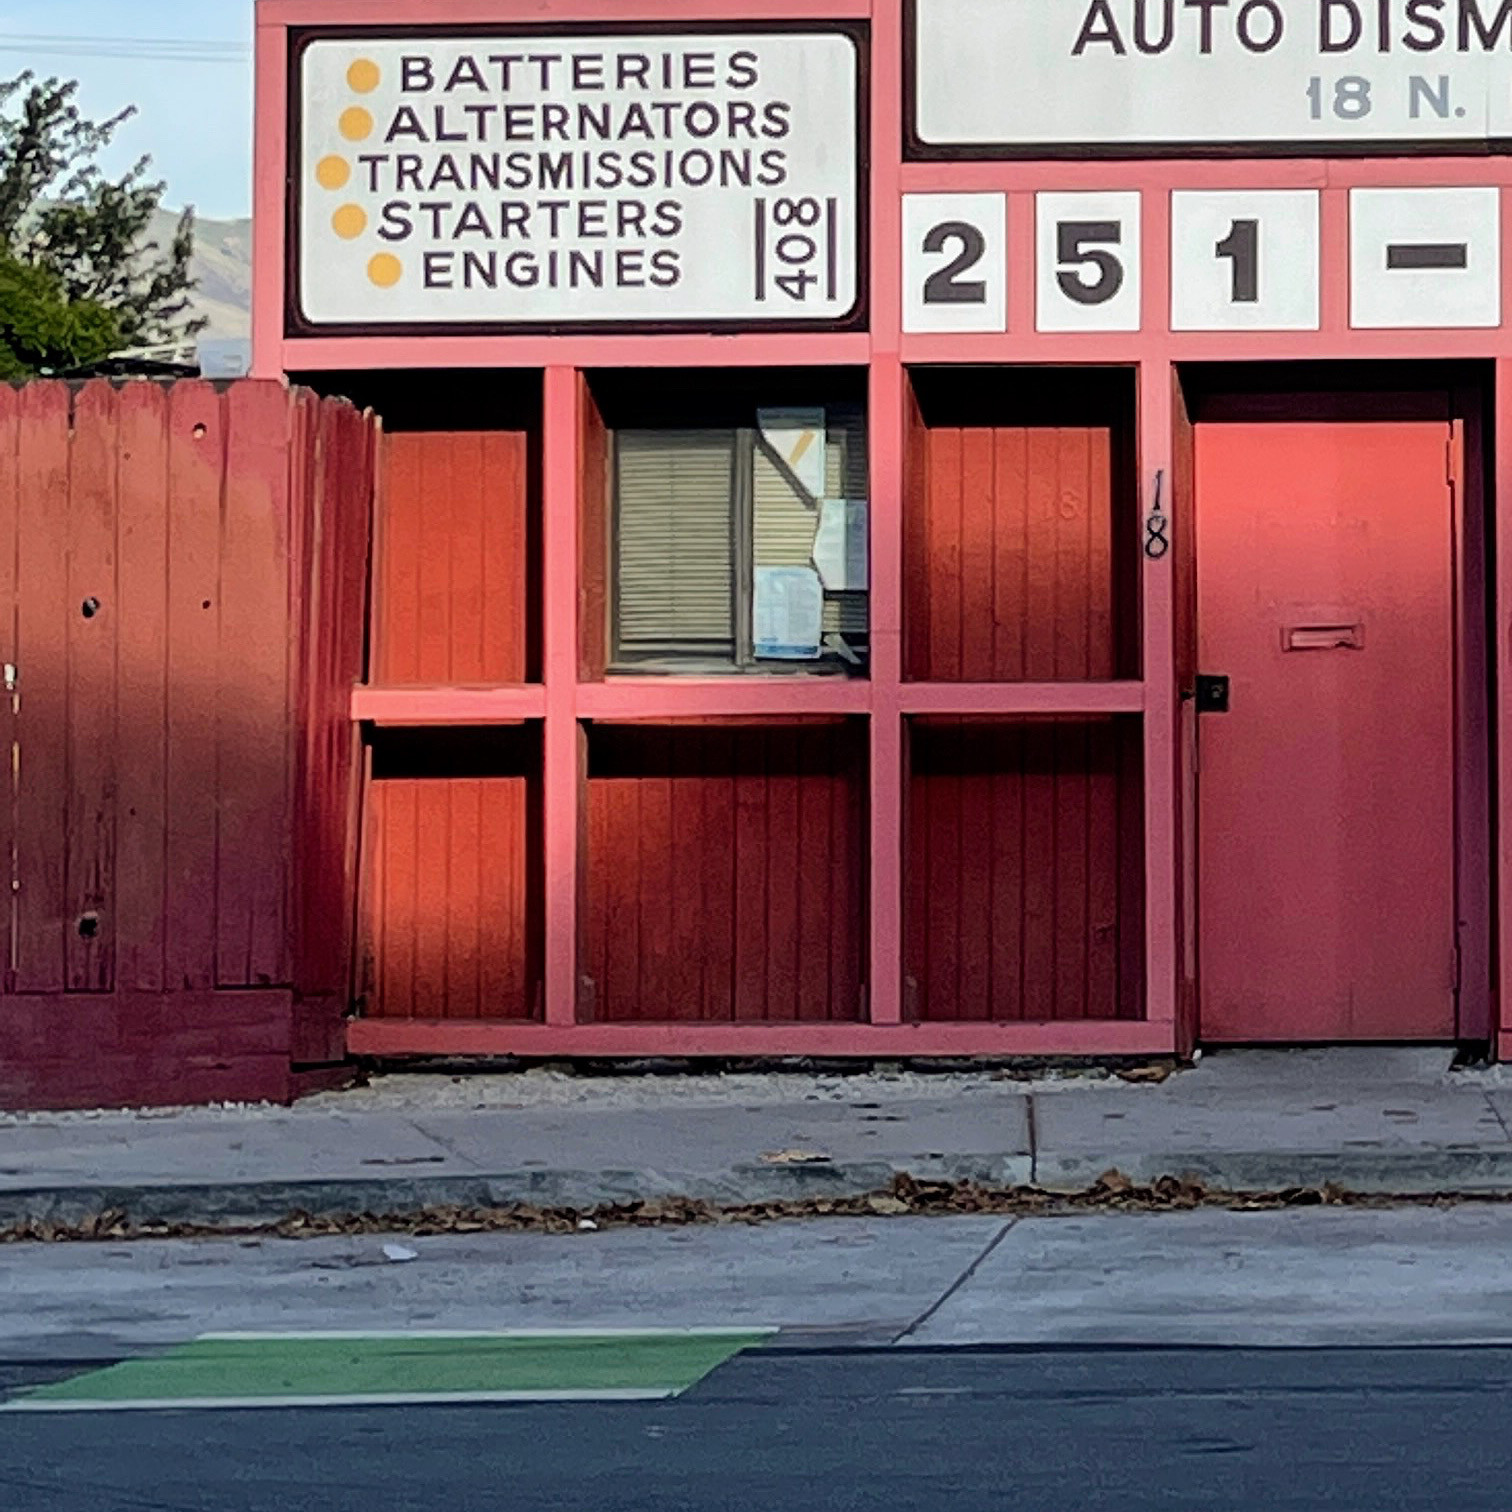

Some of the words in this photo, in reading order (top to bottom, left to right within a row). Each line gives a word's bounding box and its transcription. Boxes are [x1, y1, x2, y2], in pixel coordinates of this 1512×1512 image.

[400, 51, 760, 93] BATTERIES
[1306, 75, 1372, 120] 18
[1407, 75, 1467, 119] N.
[384, 100, 792, 143] ALTERNATORS
[357, 149, 788, 192] TRANSMISSIONS
[376, 199, 684, 241] STARTERS
[422, 249, 682, 289] ENGINES
[773, 196, 822, 302] 408
[1144, 469, 1169, 560] 18
